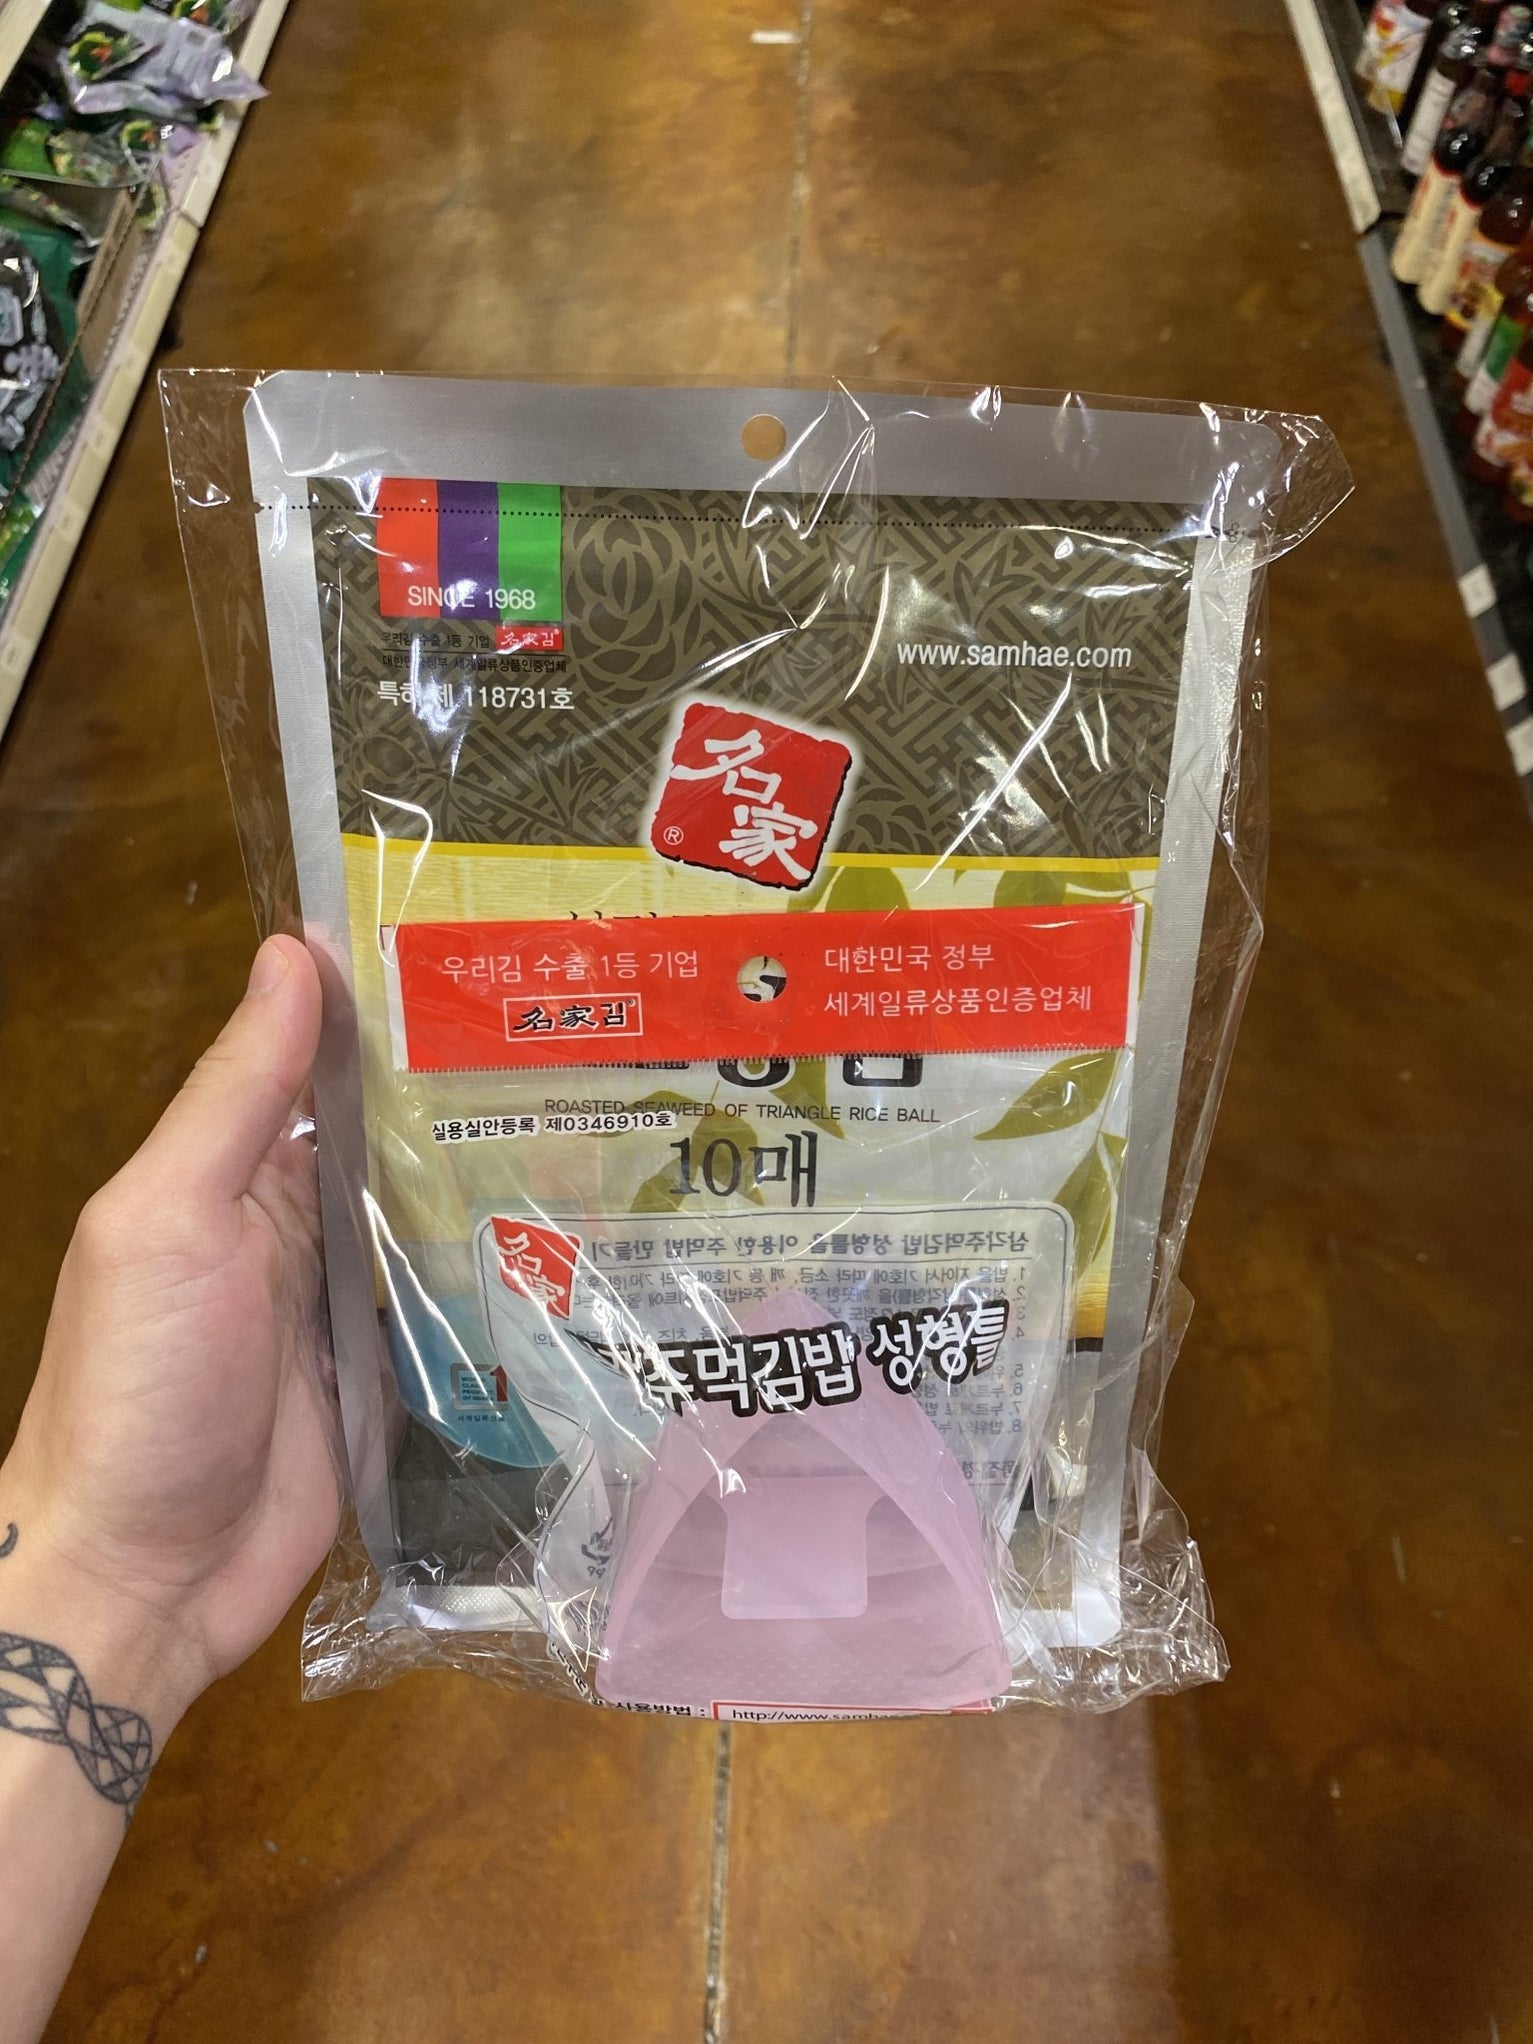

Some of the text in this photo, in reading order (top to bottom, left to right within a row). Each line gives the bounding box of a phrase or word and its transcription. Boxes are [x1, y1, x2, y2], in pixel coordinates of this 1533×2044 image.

[485, 589, 536, 610] 1968
[468, 635, 490, 649] 기업
[897, 640, 1132, 668] www.samhae.com
[465, 684, 575, 710] 118731호
[441, 949, 699, 984] 우리김 수출 1등 기업
[824, 943, 995, 974] 대한민국 정부
[823, 984, 1092, 1017] 세계일류상품인증업체
[544, 1111, 673, 1132] 제0346910호
[545, 1099, 941, 1123] ROASTED SEAWEED OF TRIANGLE RICE BALL
[670, 1130, 819, 1208] 10매
[872, 1305, 1005, 1389] 성형틀
